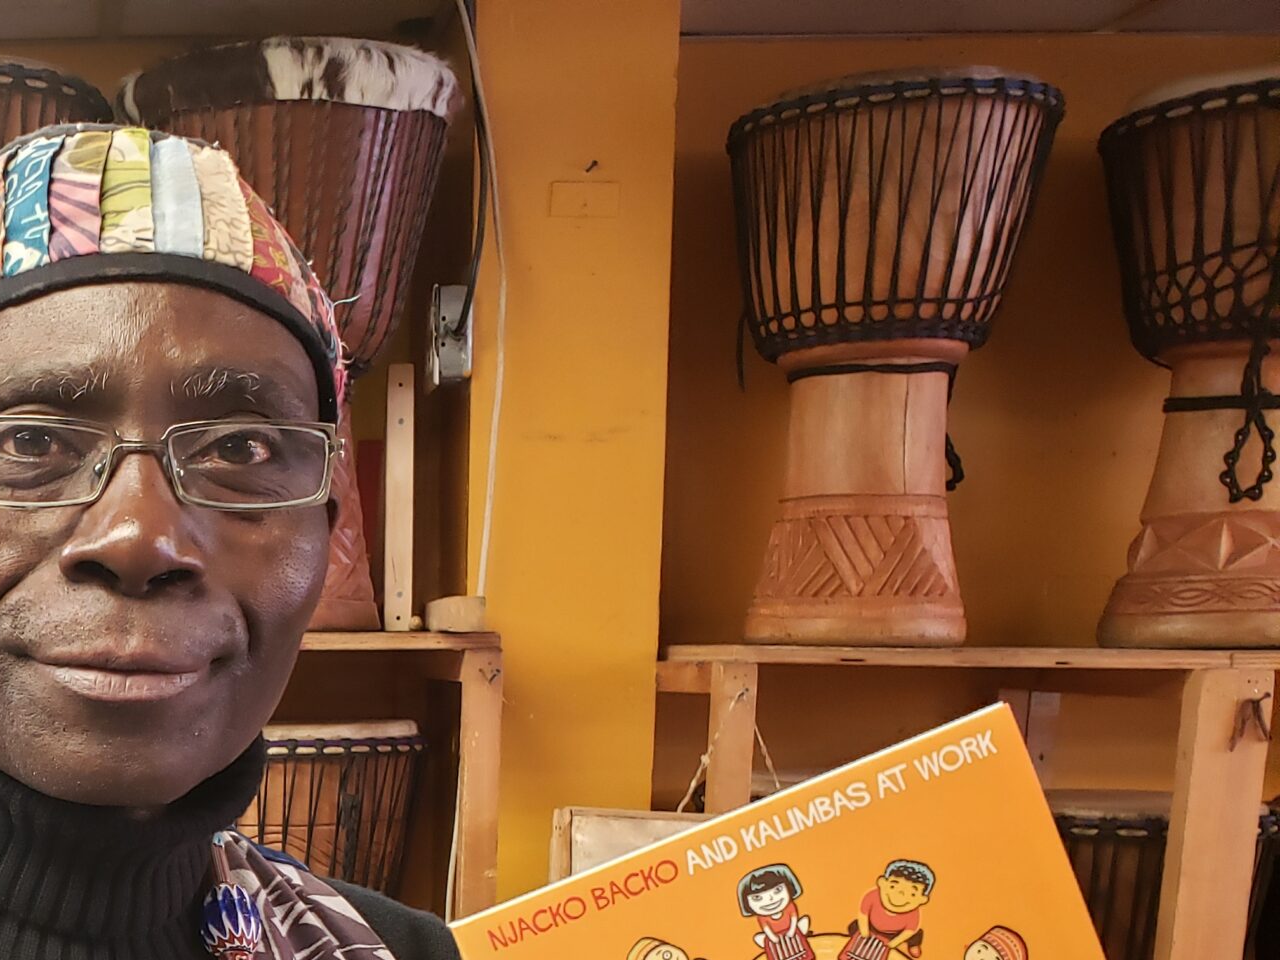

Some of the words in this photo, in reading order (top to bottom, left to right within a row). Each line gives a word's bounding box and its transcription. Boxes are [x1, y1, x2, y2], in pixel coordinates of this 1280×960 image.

[487, 896, 587, 951] NJACKO
[590, 859, 679, 911] BACKO
[686, 835, 738, 875] AND
[740, 781, 871, 852] KALIMBAS
[876, 763, 907, 799] AT
[913, 729, 998, 781] WORK
